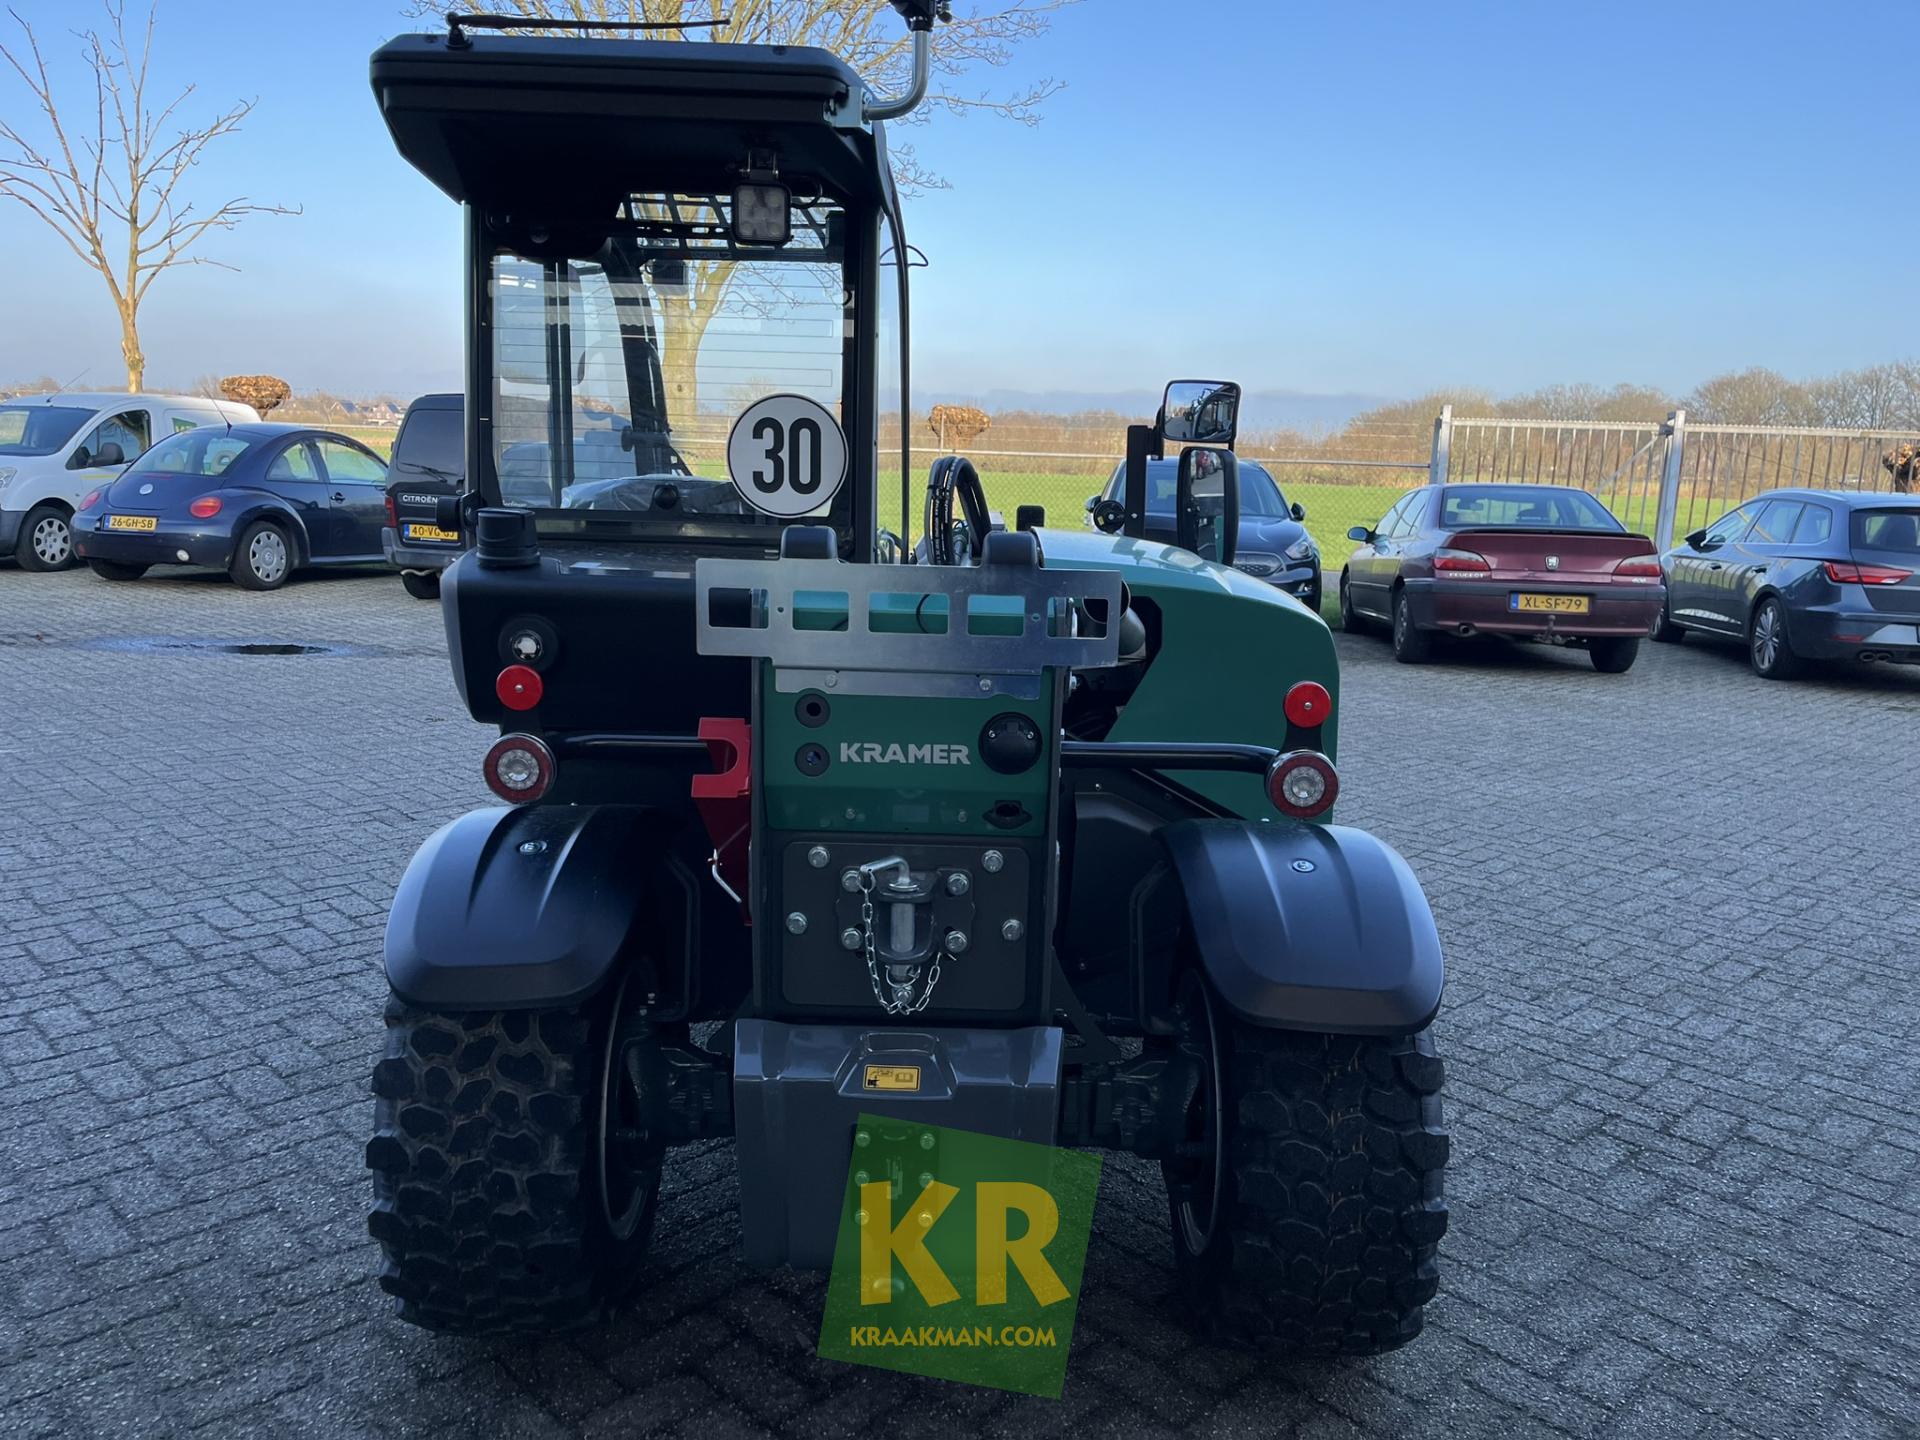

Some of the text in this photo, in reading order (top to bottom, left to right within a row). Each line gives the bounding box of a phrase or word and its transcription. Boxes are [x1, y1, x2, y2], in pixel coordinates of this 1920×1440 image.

[752, 416, 822, 495] 30
[111, 517, 154, 529] 26-GH-SB
[1524, 596, 1582, 609] XL-SF-79
[840, 742, 971, 765] KRAMER
